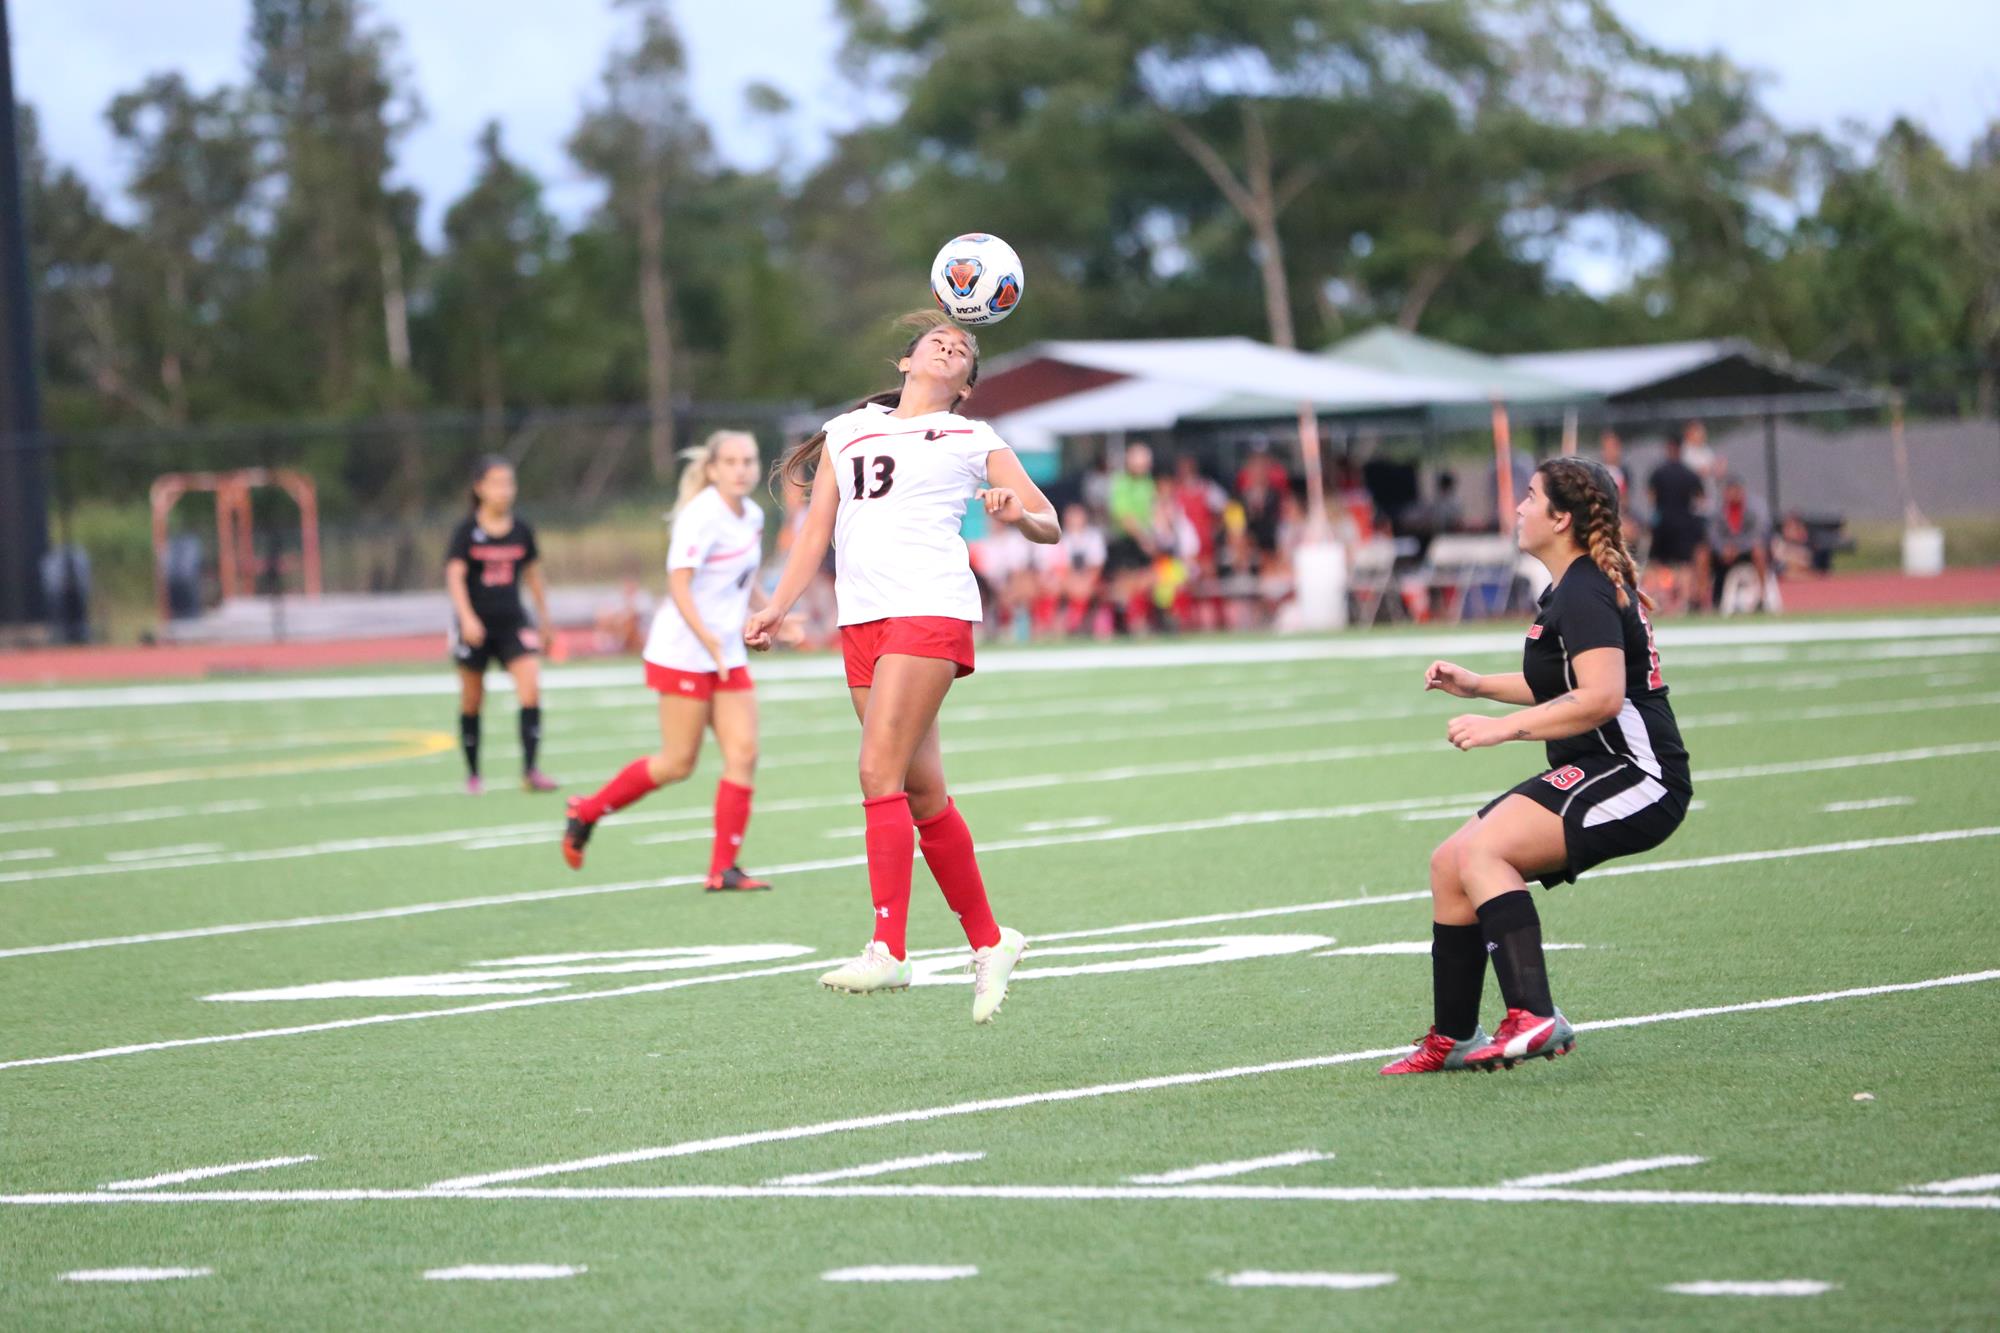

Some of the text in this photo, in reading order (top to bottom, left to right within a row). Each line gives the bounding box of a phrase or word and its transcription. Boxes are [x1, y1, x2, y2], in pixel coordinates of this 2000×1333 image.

[957, 305, 982, 314] NCAA
[851, 455, 896, 500] 13
[1541, 764, 1585, 791] 19
